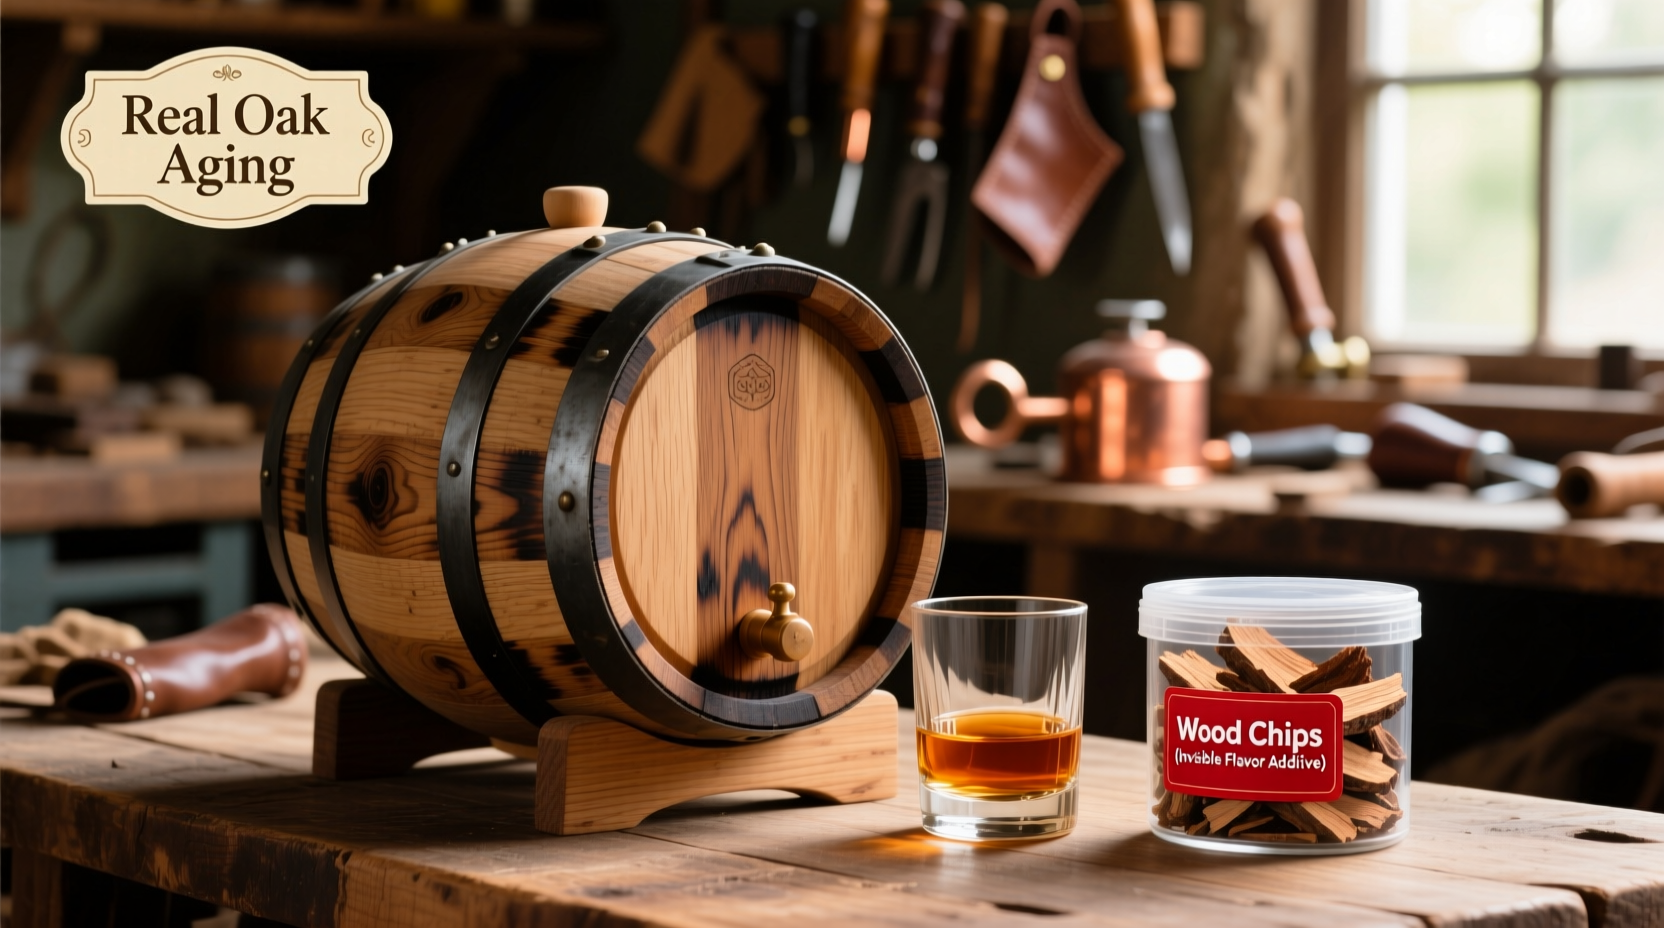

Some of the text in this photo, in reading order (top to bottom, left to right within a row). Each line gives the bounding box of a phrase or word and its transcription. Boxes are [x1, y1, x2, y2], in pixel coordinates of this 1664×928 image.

[1176, 715, 1323, 753] Wood Chips
[1225, 752, 1266, 768] Flavor
